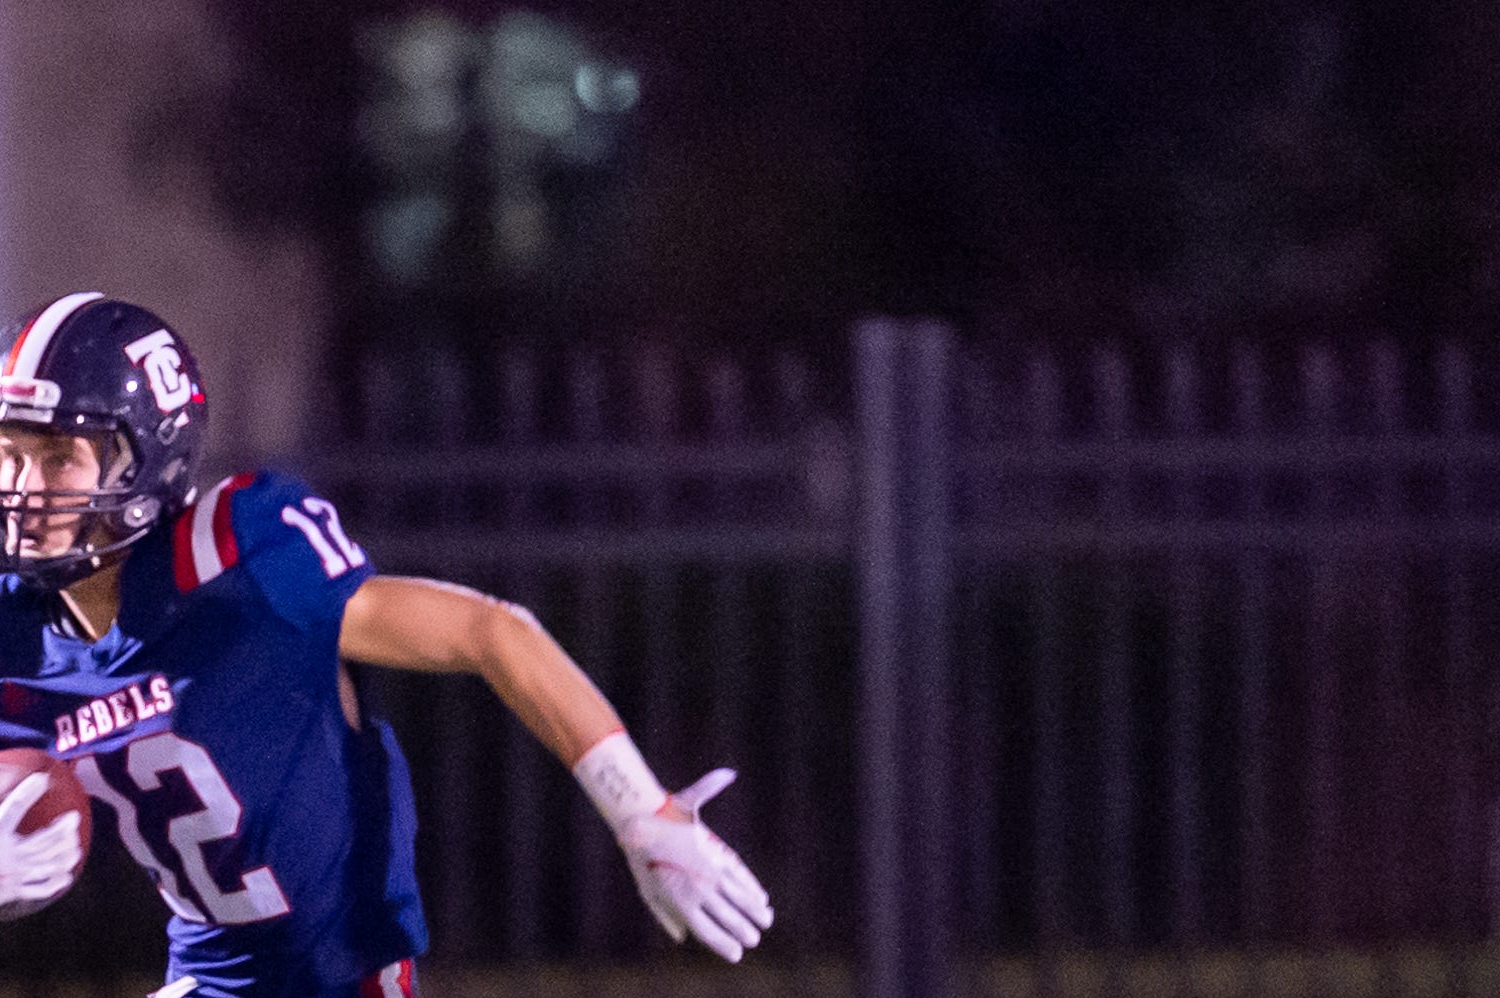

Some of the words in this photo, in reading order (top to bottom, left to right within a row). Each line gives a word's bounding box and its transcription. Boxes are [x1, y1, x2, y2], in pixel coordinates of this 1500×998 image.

[281, 497, 366, 579] 12
[55, 676, 174, 753] REBELS
[75, 732, 291, 926] 12
